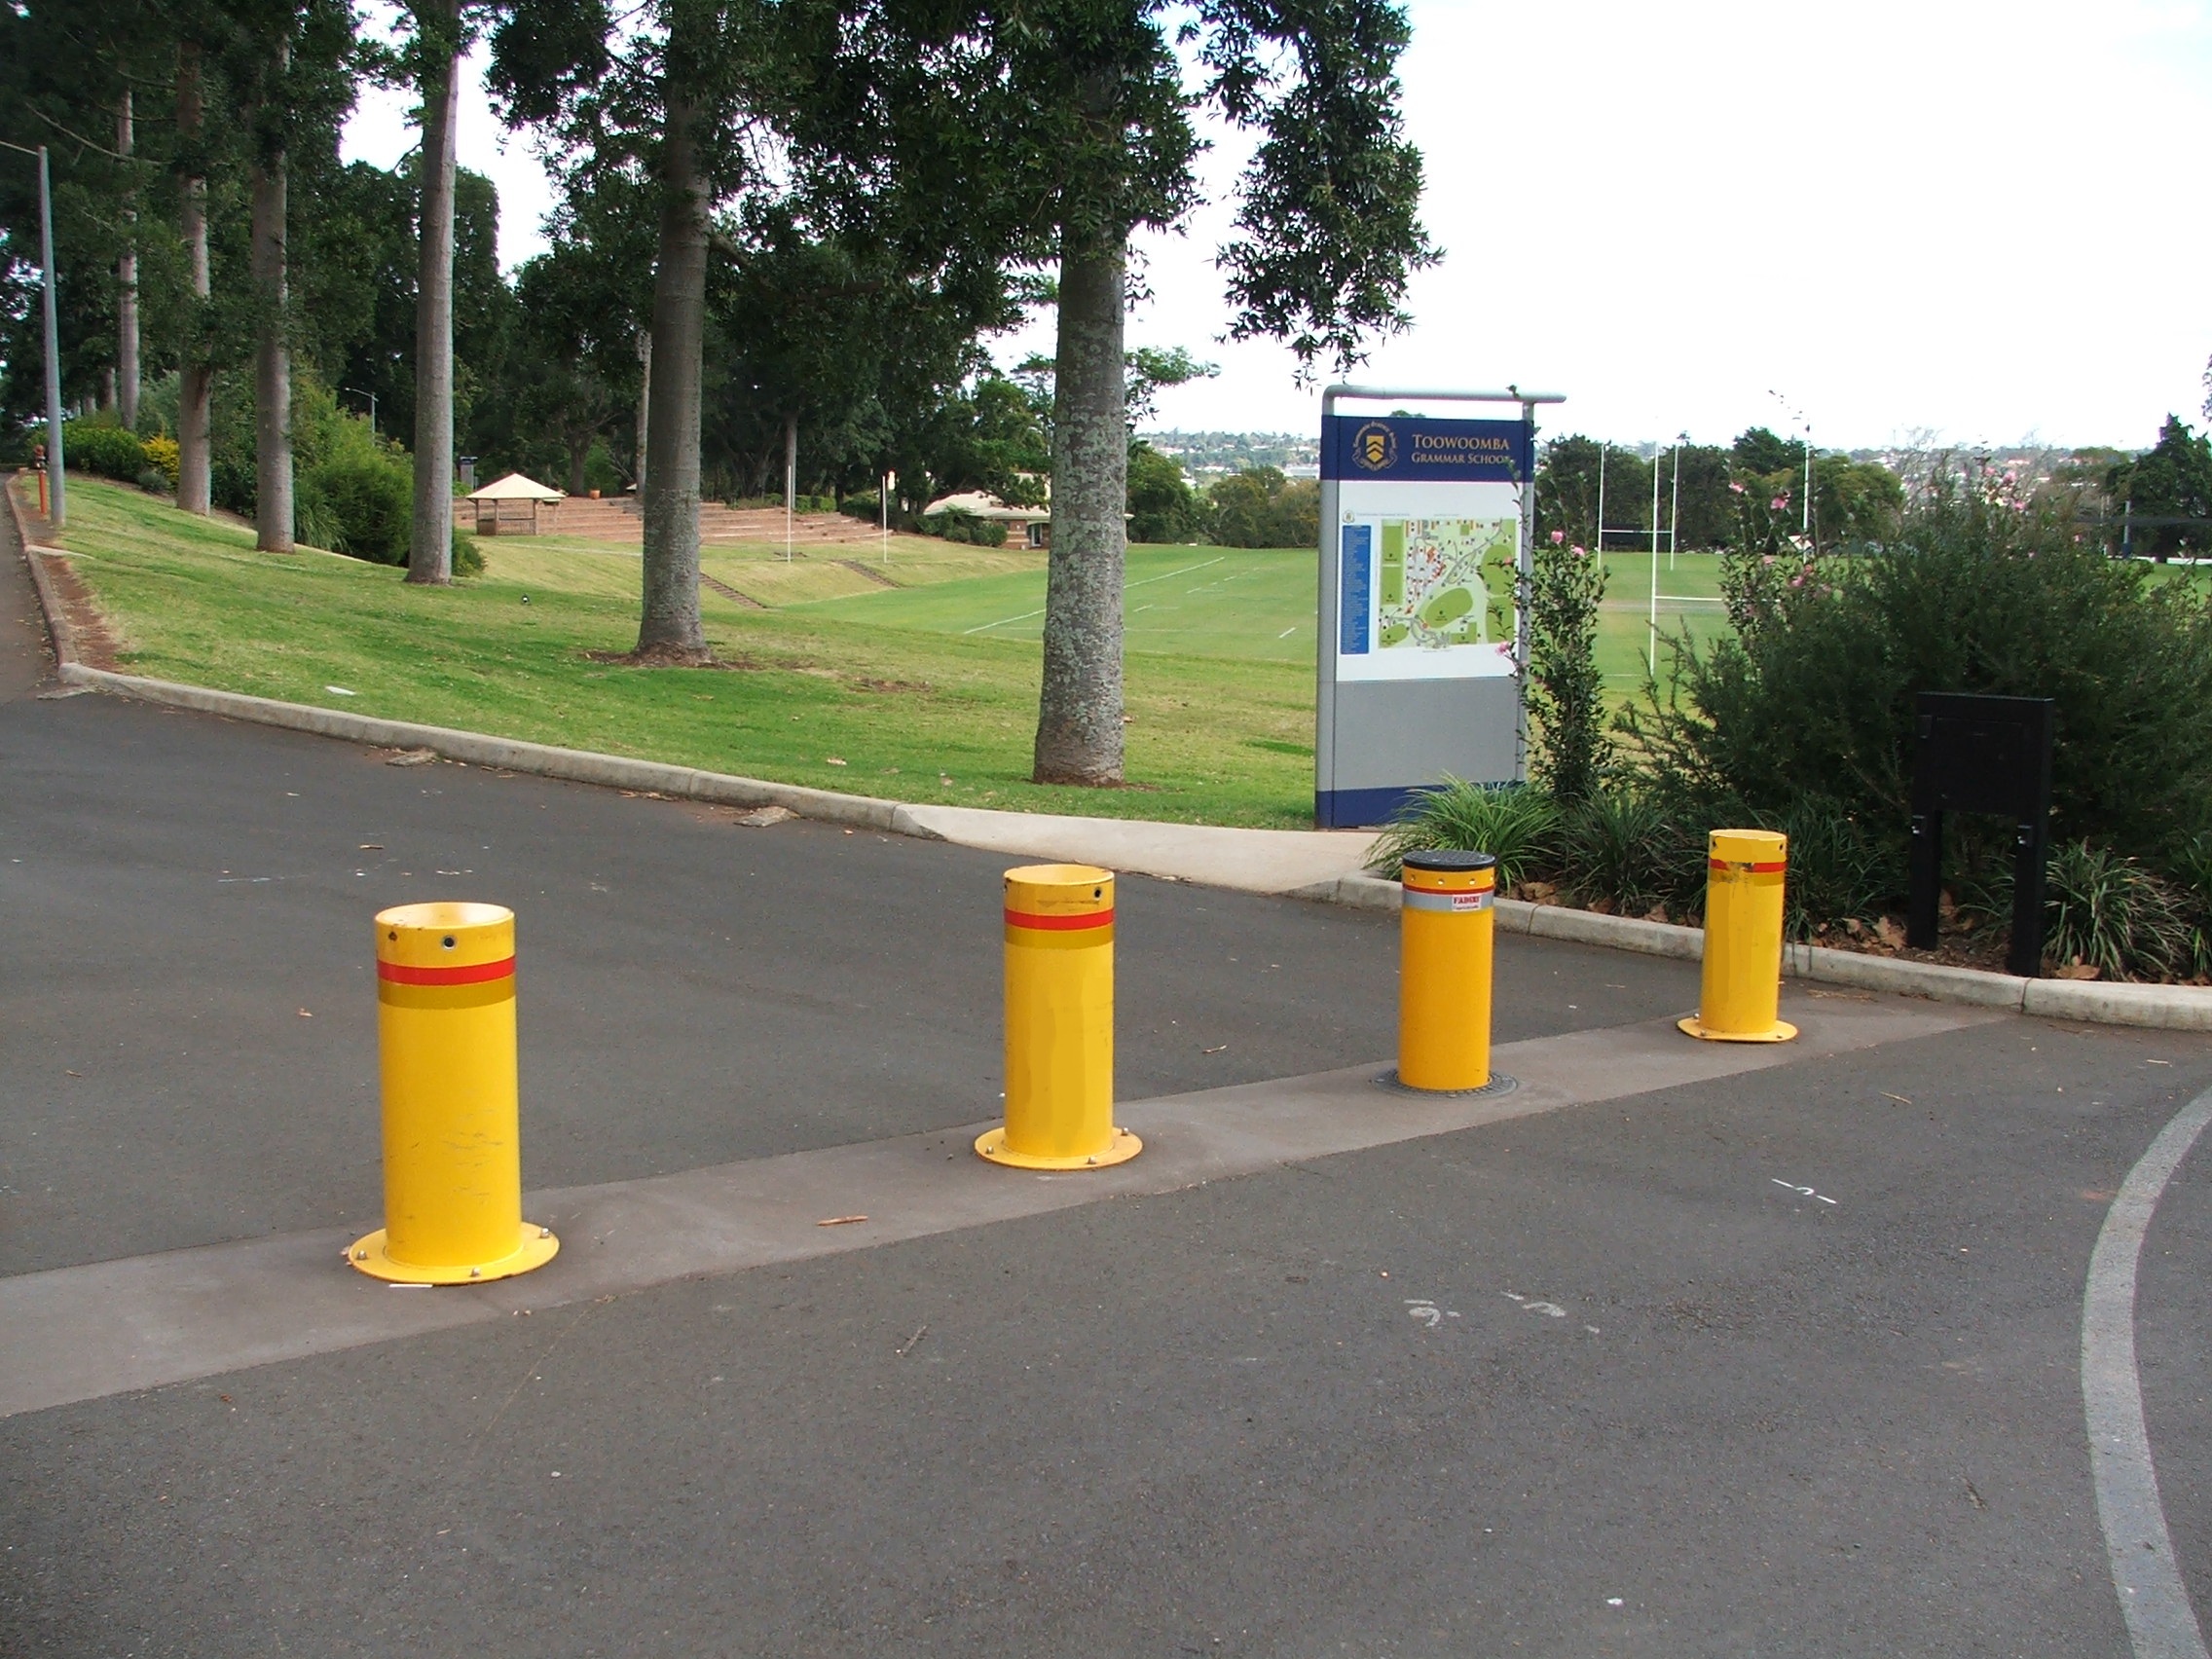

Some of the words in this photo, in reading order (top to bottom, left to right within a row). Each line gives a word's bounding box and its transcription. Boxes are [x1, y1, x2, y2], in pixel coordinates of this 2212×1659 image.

[1411, 434, 1510, 450] TOOWOOMBA
[1411, 452, 1465, 463] GRAMMAR
[1467, 453, 1508, 464] SCHOO
